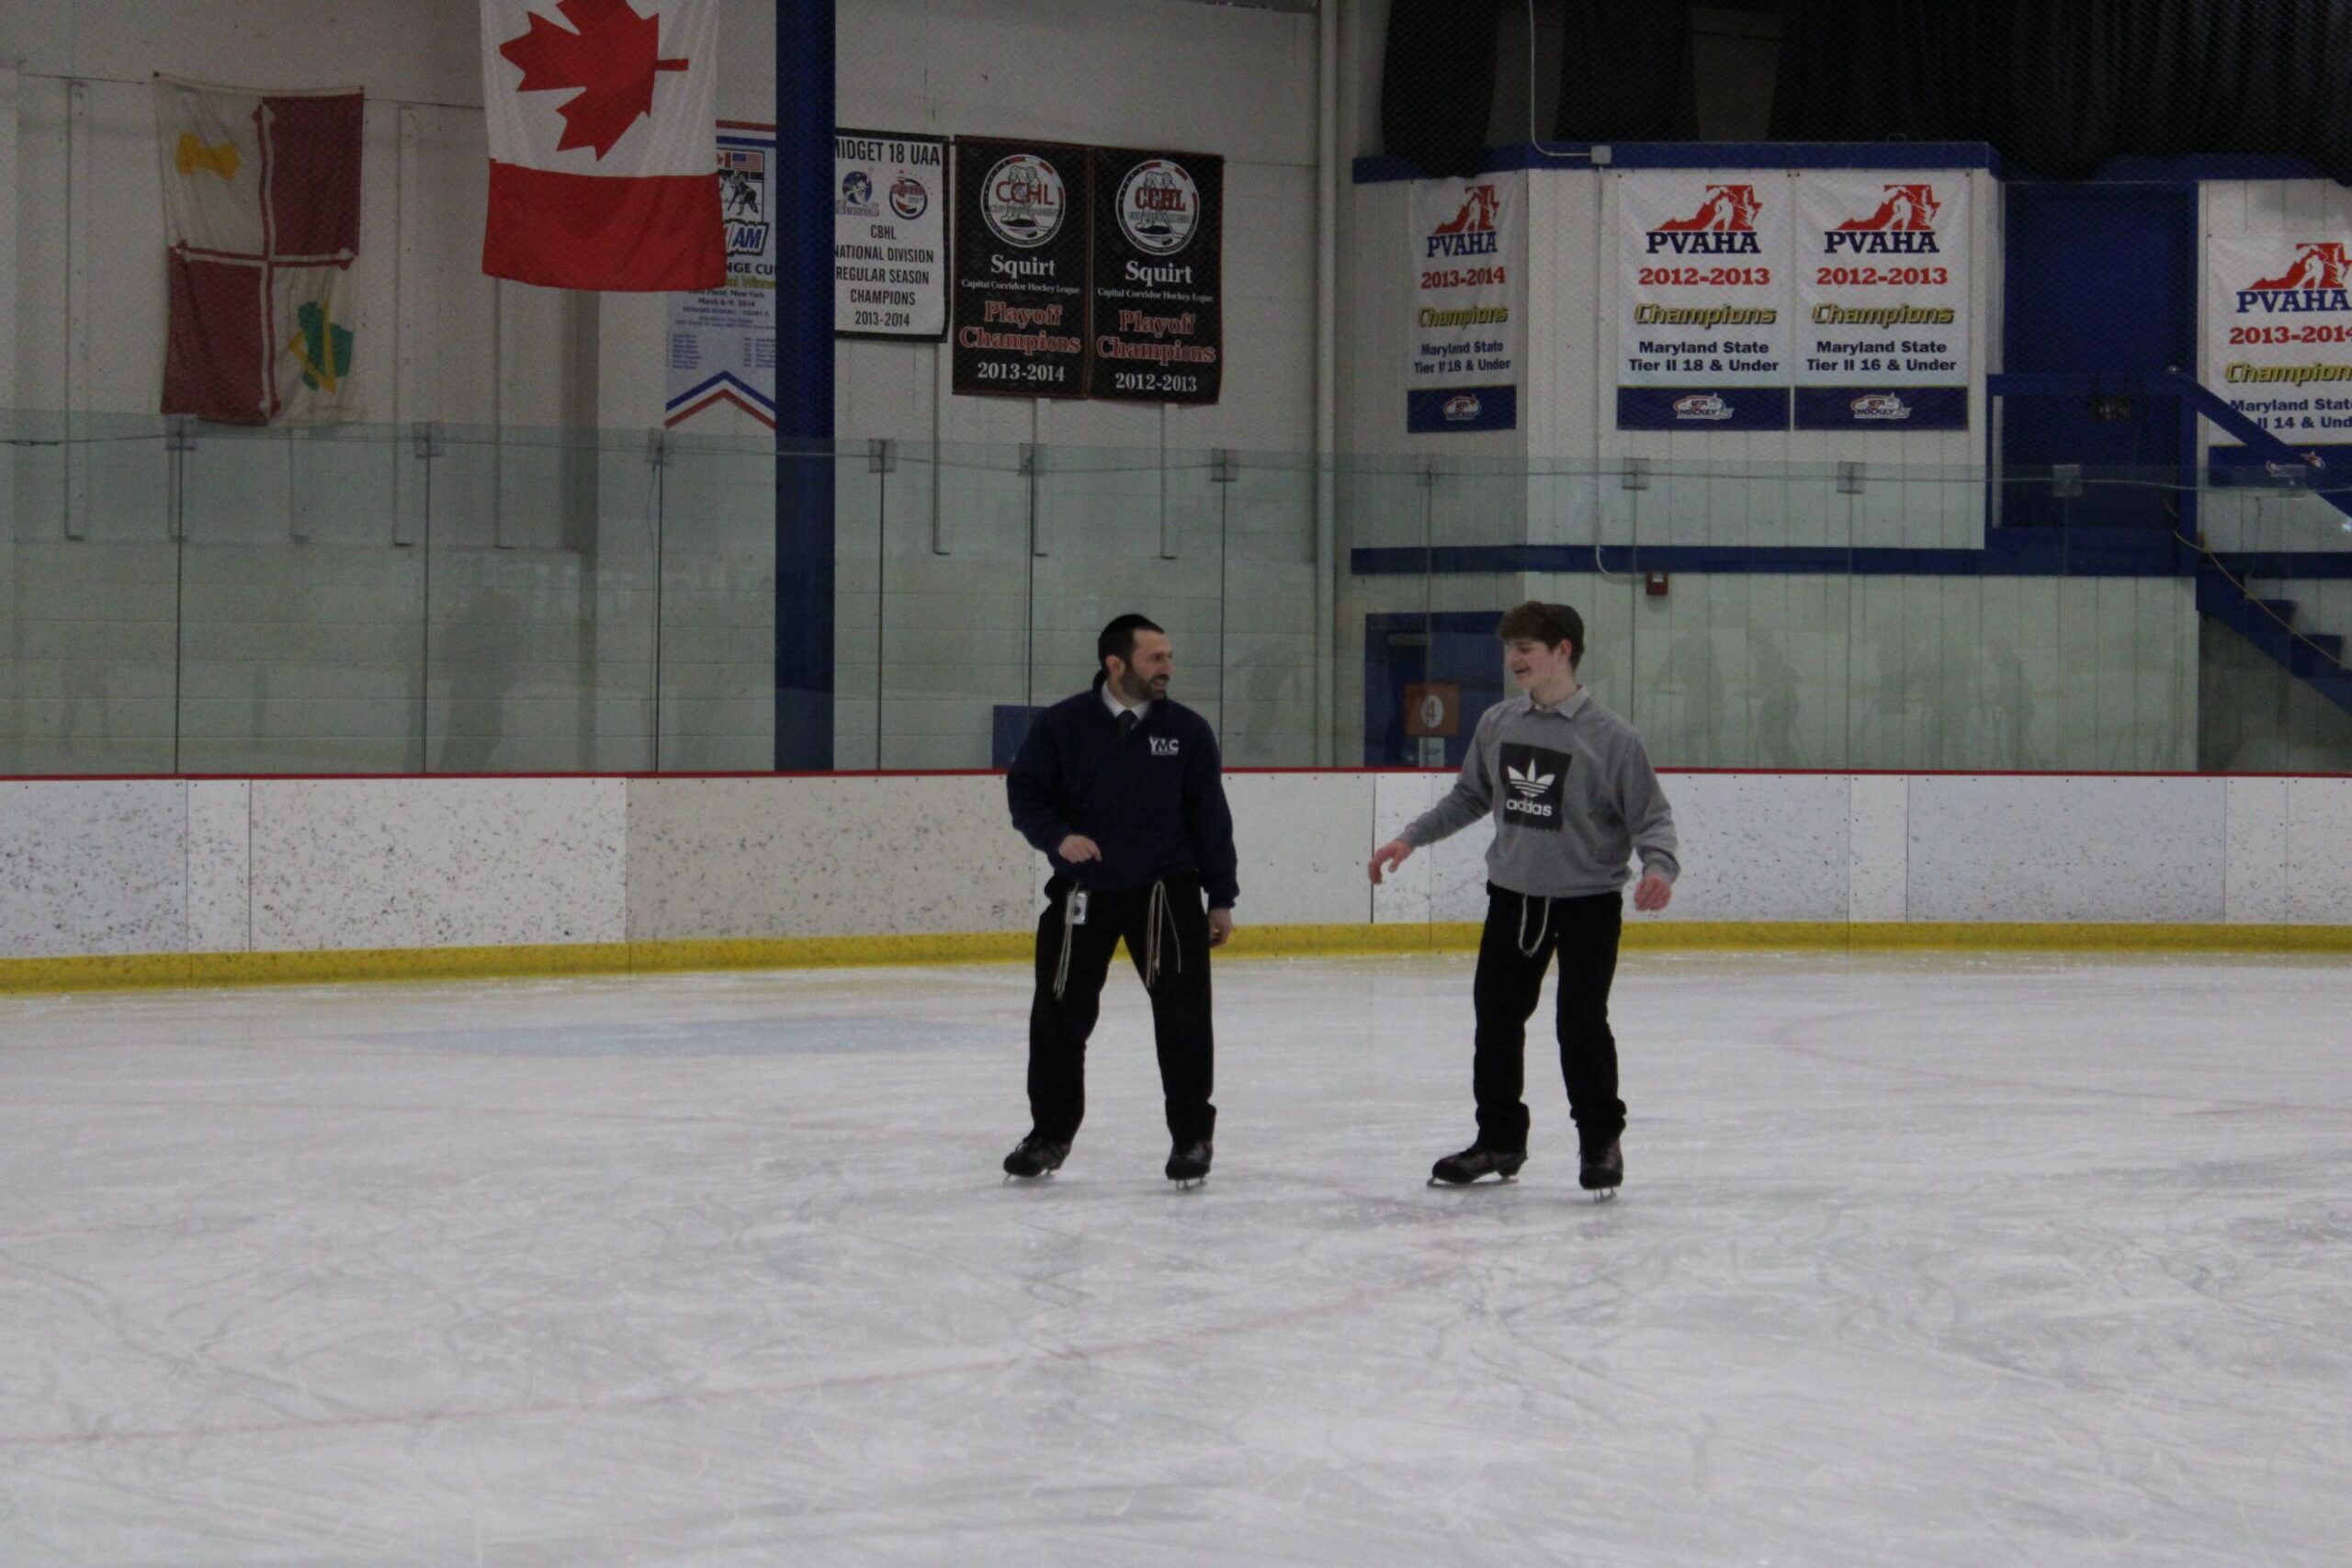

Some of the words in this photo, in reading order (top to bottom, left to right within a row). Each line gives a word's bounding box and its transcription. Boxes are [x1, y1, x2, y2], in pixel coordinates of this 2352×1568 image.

[888, 142, 905, 164] 18
[910, 144, 941, 165] UAA
[996, 181, 1055, 206] CCHL
[1135, 186, 1186, 211] CCHL
[871, 224, 897, 240] CBHL
[1426, 231, 1498, 258] PVAHA
[1645, 231, 1762, 254] PVAHA
[1824, 231, 1939, 254] PVAHA
[834, 244, 884, 261] NATIONAL
[888, 247, 933, 263] DIVISION
[755, 263, 777, 275] CU
[836, 266, 886, 282] REGULAR
[889, 269, 929, 285] SEASON
[990, 254, 1056, 278] Squirt
[1125, 260, 1193, 287] Squirt
[961, 278, 989, 289] Capital
[990, 280, 1026, 290] Corridor
[1027, 283, 1055, 293] Hockey
[1421, 266, 1506, 289] 2013-2014
[1638, 267, 1770, 286] 2012-2013
[1815, 267, 1948, 286] 2012-2013
[851, 288, 916, 306] CHAMPIONS
[1097, 287, 1125, 298] Capital
[1125, 289, 1162, 299] Corridor
[1162, 291, 1190, 302] Hockey
[2236, 289, 2352, 313] PVAHA
[855, 310, 910, 327] 2013-2014
[984, 300, 1063, 329] Playoff
[1418, 305, 1509, 331] Champions
[1634, 302, 1777, 329] Champions
[1812, 302, 1955, 329] Champions
[959, 325, 1081, 356] Champions
[1420, 342, 1470, 357] Maryland
[1474, 340, 1504, 353] State
[1638, 341, 1717, 355] Maryland
[1723, 341, 1770, 355] State
[1816, 341, 1895, 355] Maryland
[1901, 341, 1947, 355] State
[1096, 335, 1216, 366] Champions
[977, 362, 1065, 382] 2013-2014
[1414, 362, 1435, 374] Tier
[1465, 359, 1474, 371] &
[1477, 358, 1511, 370] Under
[1629, 359, 1661, 372] Tier
[1682, 359, 1704, 372] 18
[1709, 359, 1724, 372] &
[1728, 359, 1780, 372] Under
[1806, 359, 1839, 372] Tier
[1843, 359, 1855, 371] II
[1860, 359, 1882, 372] 16
[1887, 359, 1901, 372] &
[1906, 359, 1957, 372] Under
[1114, 372, 1197, 392] 2012-2013
[2230, 399, 2309, 414] Maryland
[2314, 398, 2352, 411] Stat
[2274, 416, 2295, 429] 14
[2301, 416, 2314, 429] &
[1148, 736, 1179, 750] YMC
[1506, 797, 1553, 817] addas
